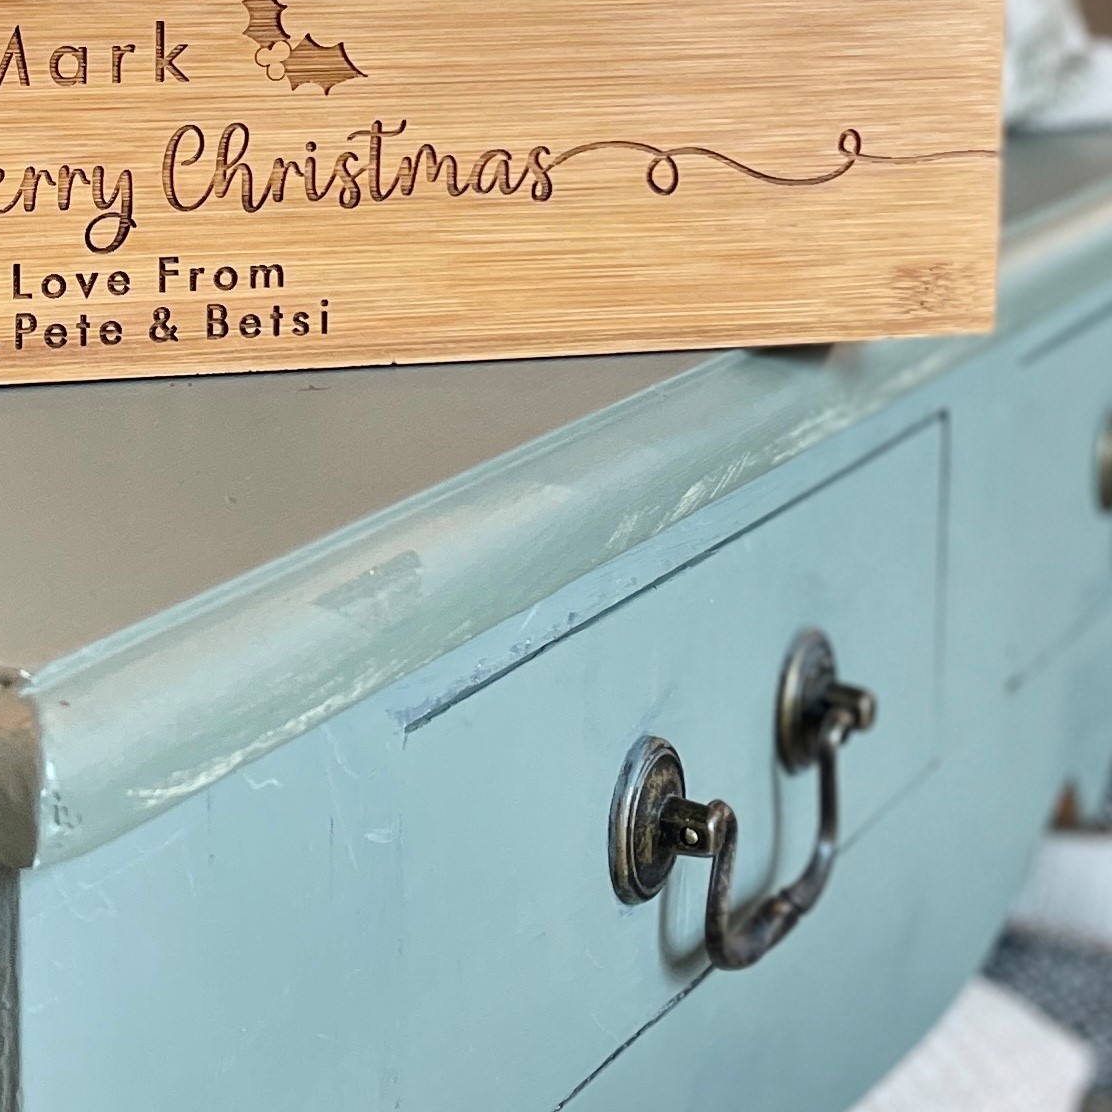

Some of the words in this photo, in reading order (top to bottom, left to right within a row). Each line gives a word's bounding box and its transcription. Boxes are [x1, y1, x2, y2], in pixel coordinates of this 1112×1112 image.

[161, 119, 555, 215] Christmas
[13, 262, 131, 300] Love
[157, 256, 286, 294] From
[148, 305, 179, 344] &
[205, 298, 331, 341] Betsi
